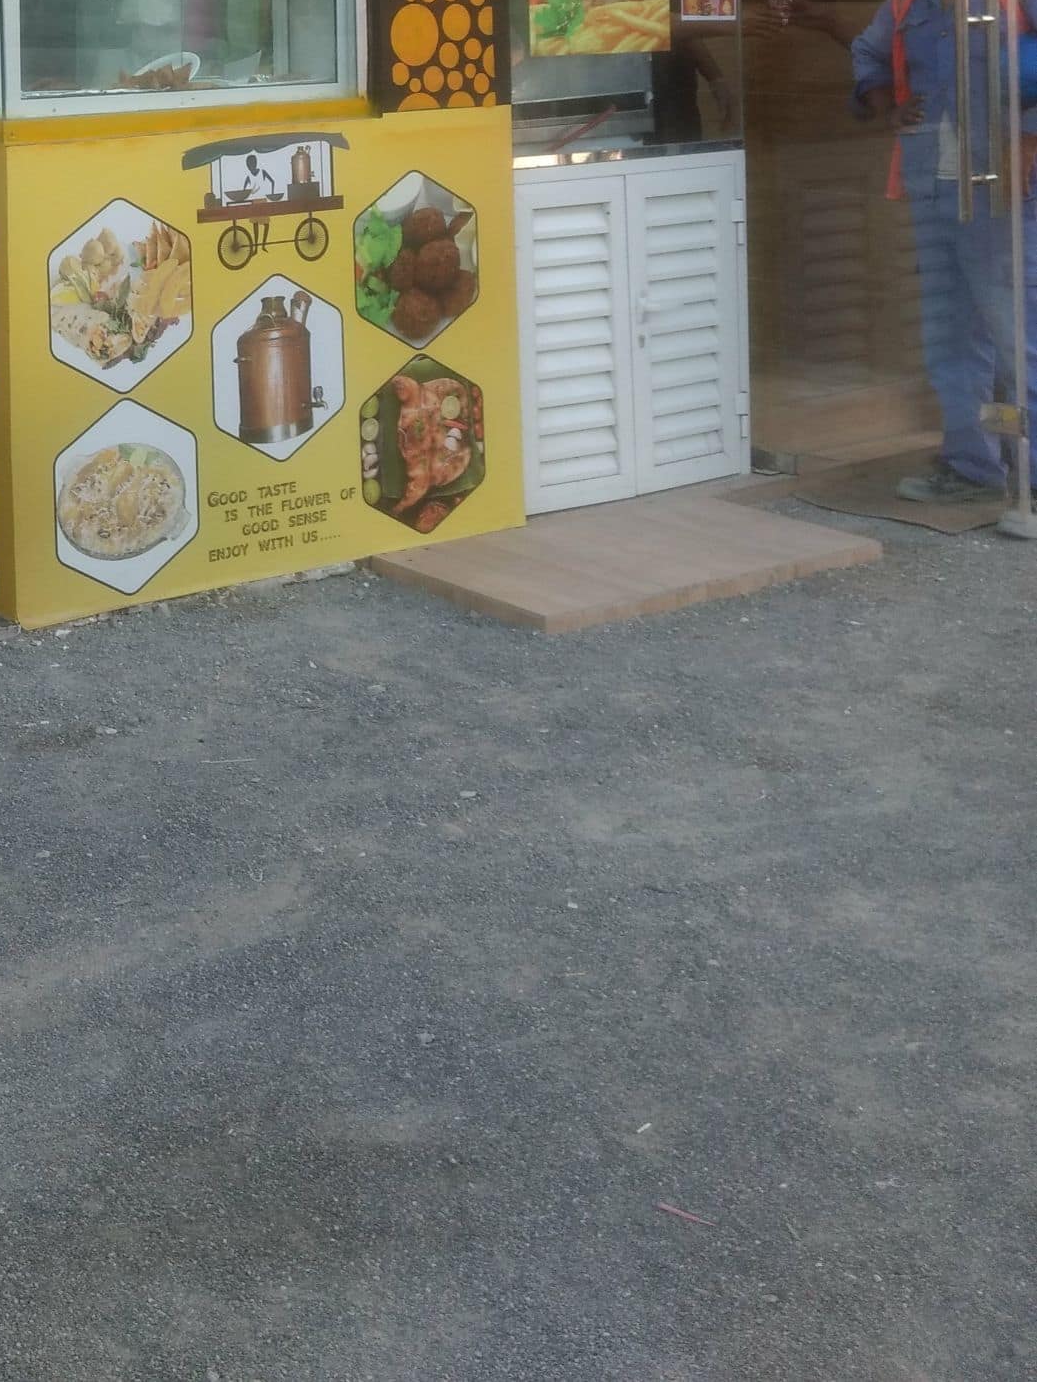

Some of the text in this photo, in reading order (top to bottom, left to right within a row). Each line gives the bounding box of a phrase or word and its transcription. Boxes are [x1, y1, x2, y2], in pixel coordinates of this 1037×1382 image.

[207, 481, 297, 508] GOOD TASTE
[224, 487, 356, 522] IS THE FLOWER OF
[242, 509, 328, 536] GOOD SENSE
[208, 543, 249, 562] ENJOY
[258, 534, 294, 552] WITH
